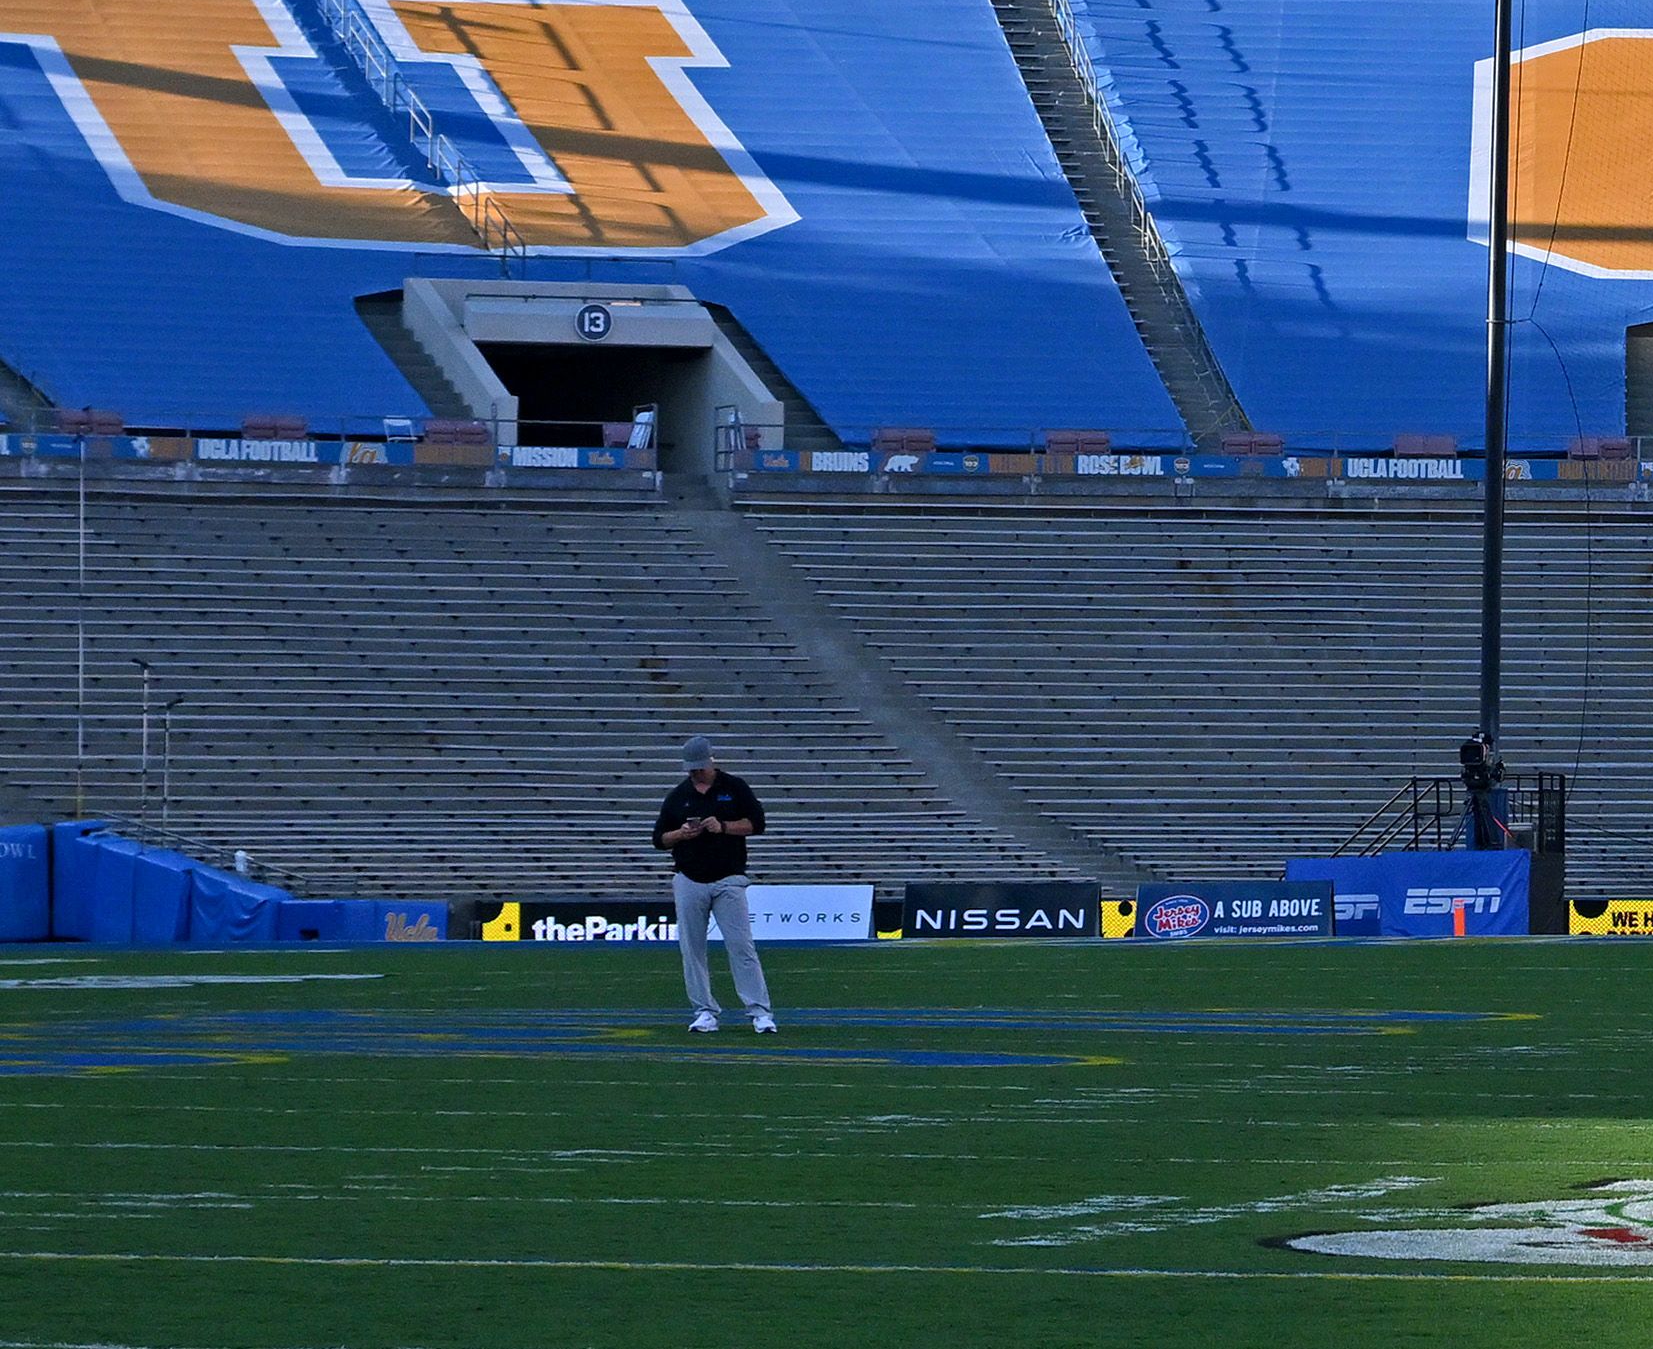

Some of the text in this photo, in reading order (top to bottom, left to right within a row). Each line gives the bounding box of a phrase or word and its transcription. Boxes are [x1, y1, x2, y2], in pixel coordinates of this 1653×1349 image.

[584, 312, 605, 332] 13
[198, 439, 240, 461] UCLA
[241, 441, 318, 463] FOOTBALL
[512, 447, 578, 467] MISSION
[812, 452, 869, 472] BRUINS
[1078, 456, 1118, 474] ROSE
[1120, 456, 1163, 475] BOWL
[1347, 459, 1388, 477] UCLA
[1389, 459, 1463, 479] FOOTBALL
[1214, 901, 1224, 918] A
[1232, 900, 1262, 918] SUB
[1404, 888, 1502, 915] ESPN
[749, 911, 861, 923] ETWORKS
[915, 908, 1085, 930] NISSAN
[1154, 902, 1201, 922] Jersey
[1612, 912, 1640, 928] WE
[1214, 924, 1318, 935] visit: jerseymikes.com
